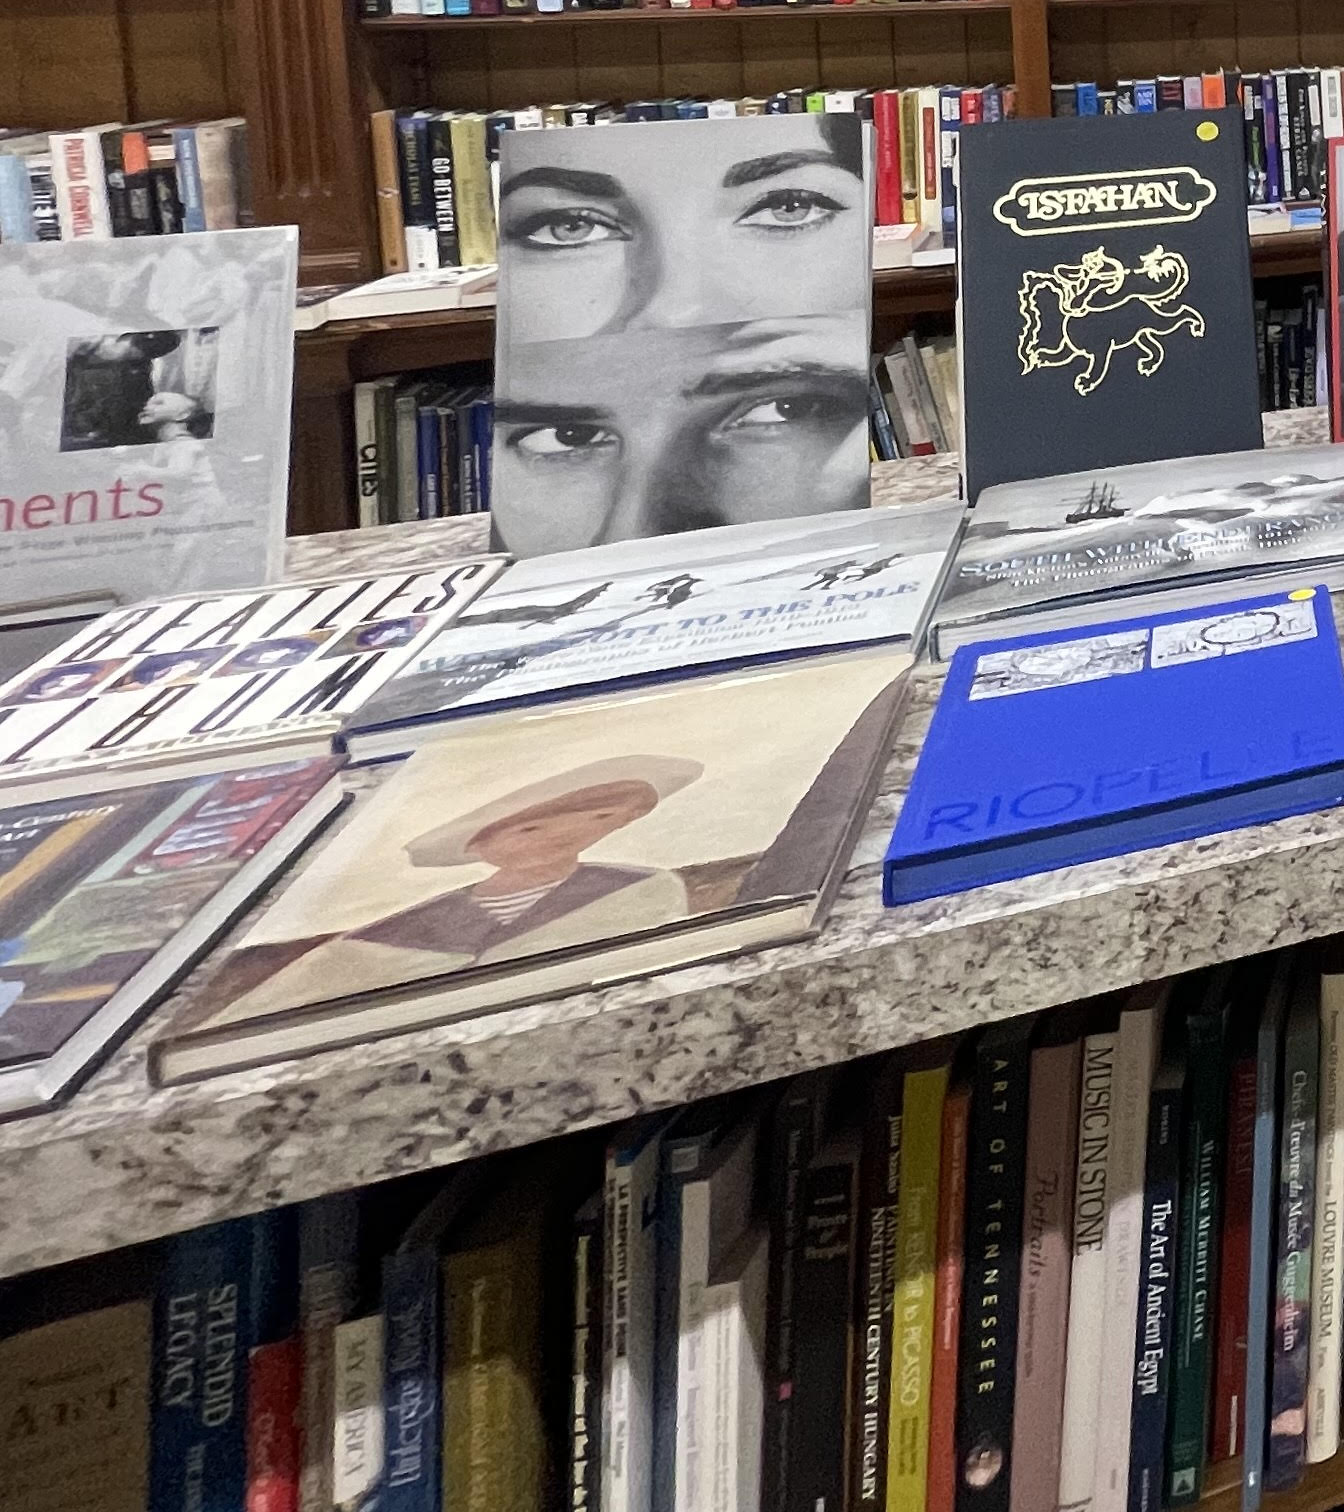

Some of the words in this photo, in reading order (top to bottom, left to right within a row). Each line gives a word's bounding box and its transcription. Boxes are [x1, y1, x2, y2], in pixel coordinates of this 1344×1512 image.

[442, 156, 460, 174] GO
[443, 178, 464, 232] BETWEEN
[1020, 180, 1195, 222] ISFAHAN
[959, 551, 1073, 578] SOUTH
[1085, 536, 1165, 561] WITH
[62, 563, 488, 665] BEATLES
[678, 613, 728, 631] TO
[737, 598, 813, 621] THE
[821, 581, 921, 609] POLE
[993, 1058, 1010, 1113] ART
[1081, 1046, 1114, 1133] MUSIC
[987, 1138, 1007, 1176] OF
[1079, 1136, 1108, 1165] IN
[1075, 1169, 1107, 1257] STONE
[1150, 1199, 1172, 1230] The
[1320, 1199, 1338, 1266] LOUVRE
[868, 1206, 886, 1323] NINETEENTH
[1147, 1263, 1169, 1282] of
[1148, 1231, 1171, 1263] Art
[977, 1199, 1002, 1395] TENNESSEE
[1141, 1283, 1168, 1349] Ancient
[1282, 1253, 1303, 1353] Guggenheim
[161, 1292, 198, 1407] LEGACY
[202, 1283, 238, 1428] SPLENDID
[864, 1324, 883, 1407] CENTURY
[901, 1324, 923, 1408] PICASSO
[1137, 1349, 1164, 1396] Egypt
[861, 1412, 879, 1501] HUNGARY
